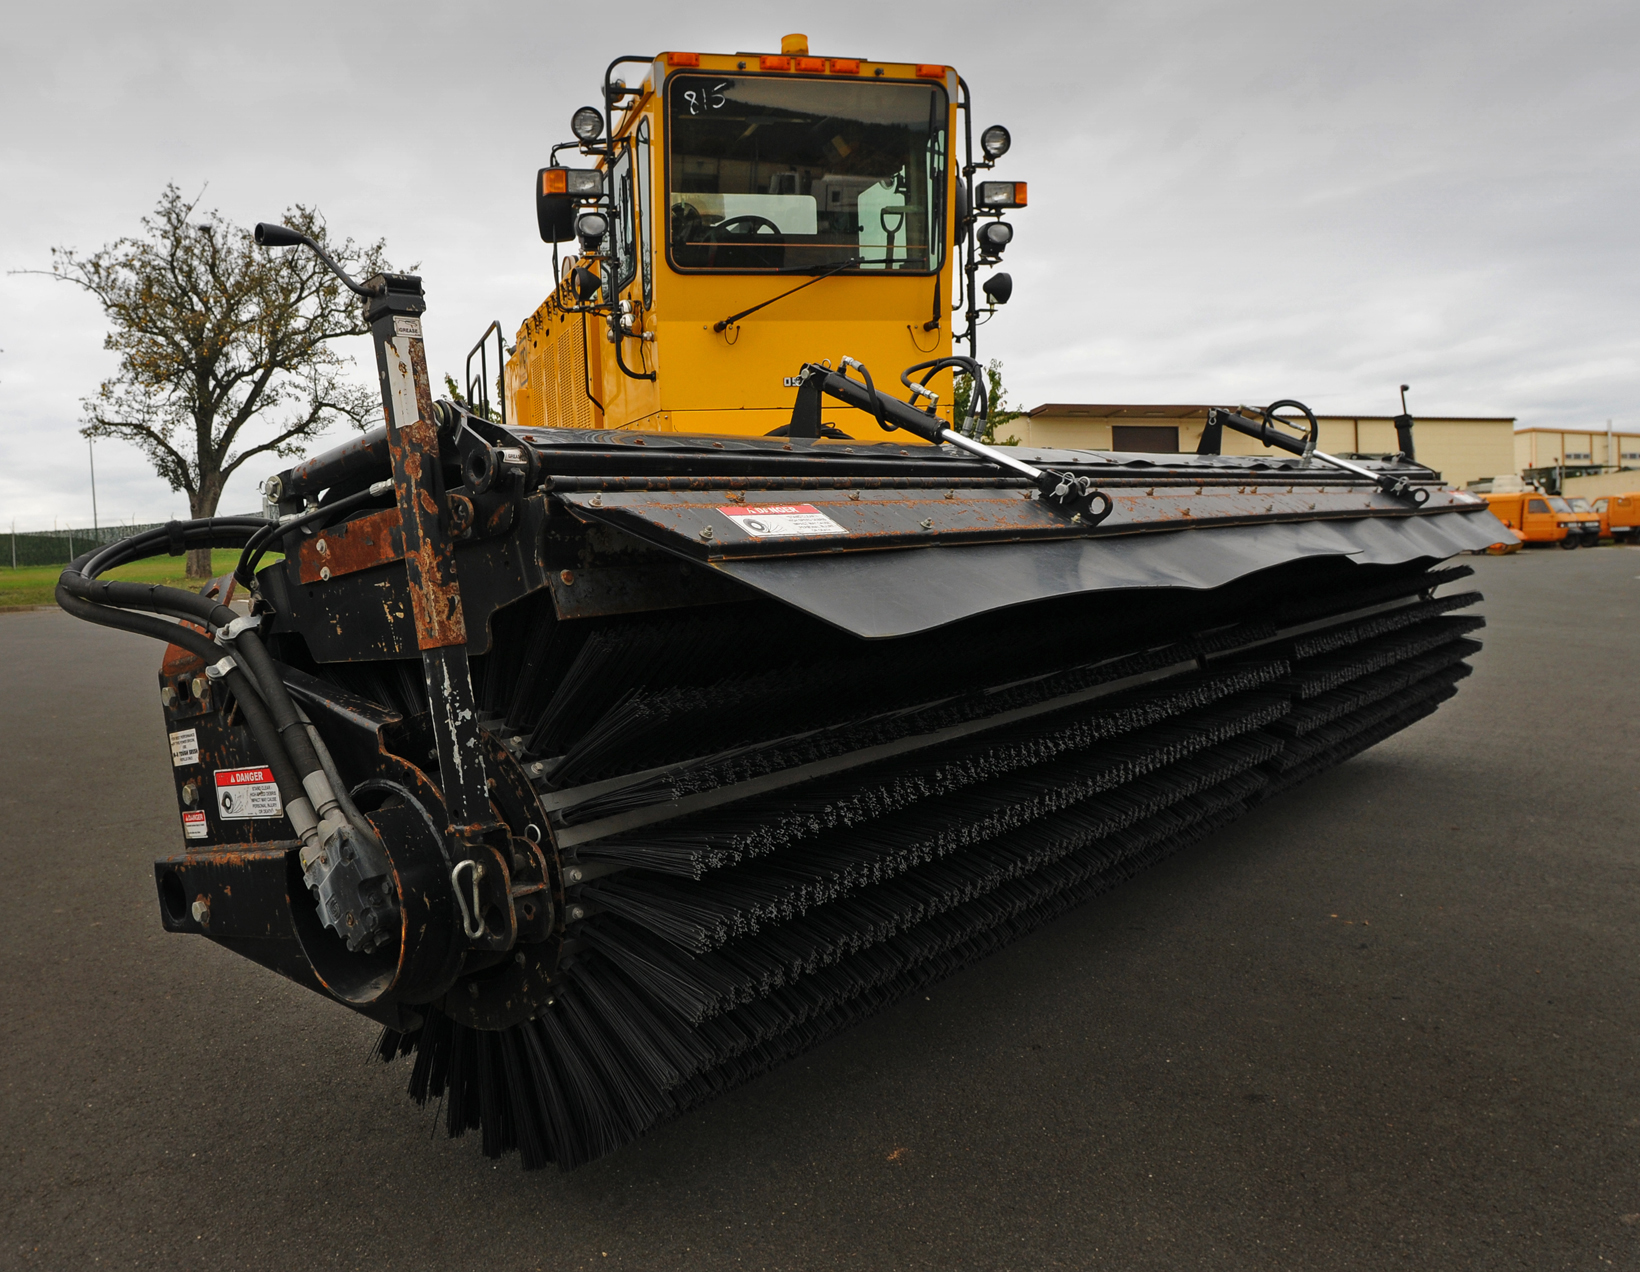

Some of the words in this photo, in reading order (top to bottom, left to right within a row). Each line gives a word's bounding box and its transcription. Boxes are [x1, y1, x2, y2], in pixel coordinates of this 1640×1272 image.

[684, 82, 727, 115] 815
[754, 506, 800, 514] DANGER
[235, 771, 264, 783] DANGER
[188, 813, 204, 821] DANGER
